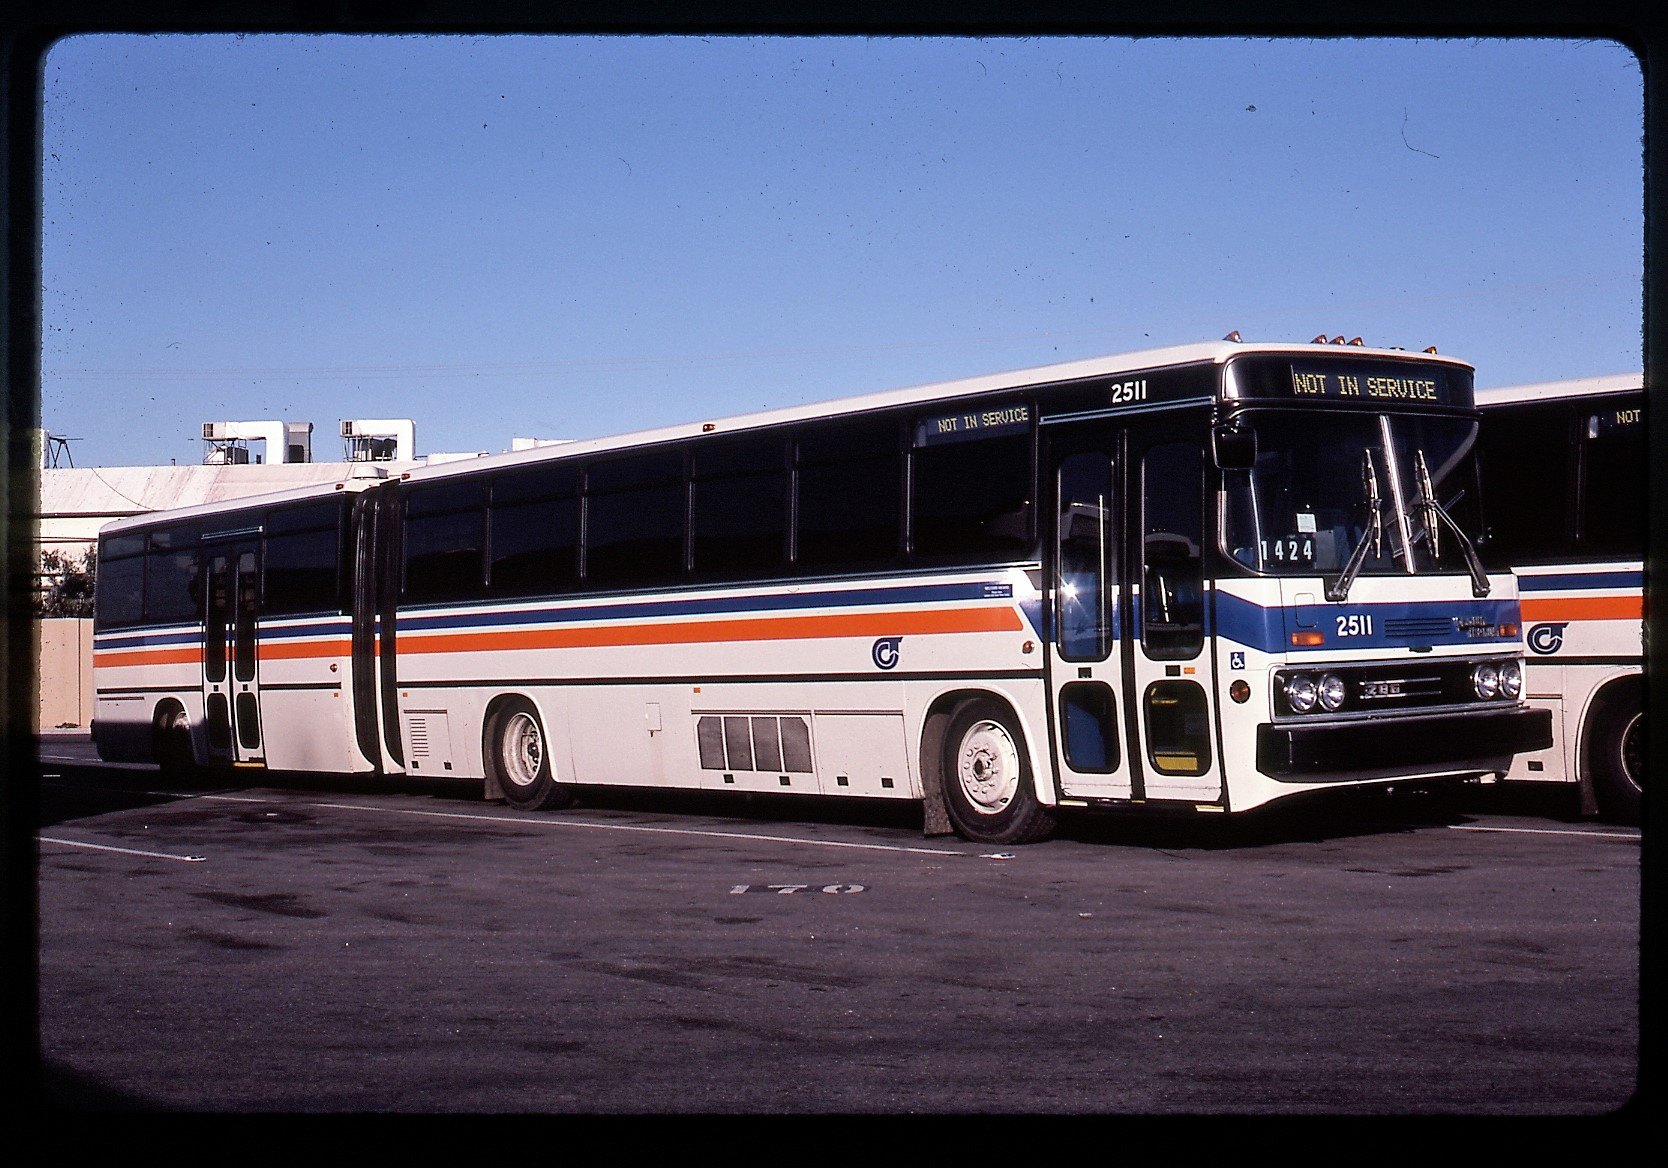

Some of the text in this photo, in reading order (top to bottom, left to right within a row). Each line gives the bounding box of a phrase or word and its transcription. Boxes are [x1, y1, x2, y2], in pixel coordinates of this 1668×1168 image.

[1111, 380, 1147, 403] 2511
[1294, 373, 1437, 400] NOT IN SERVICE
[937, 407, 1029, 433] NOT IN SERVICE
[1616, 409, 1641, 424] NOT
[1261, 540, 1313, 560] 1424
[1336, 614, 1373, 637] 2511
[730, 884, 865, 894] 170
